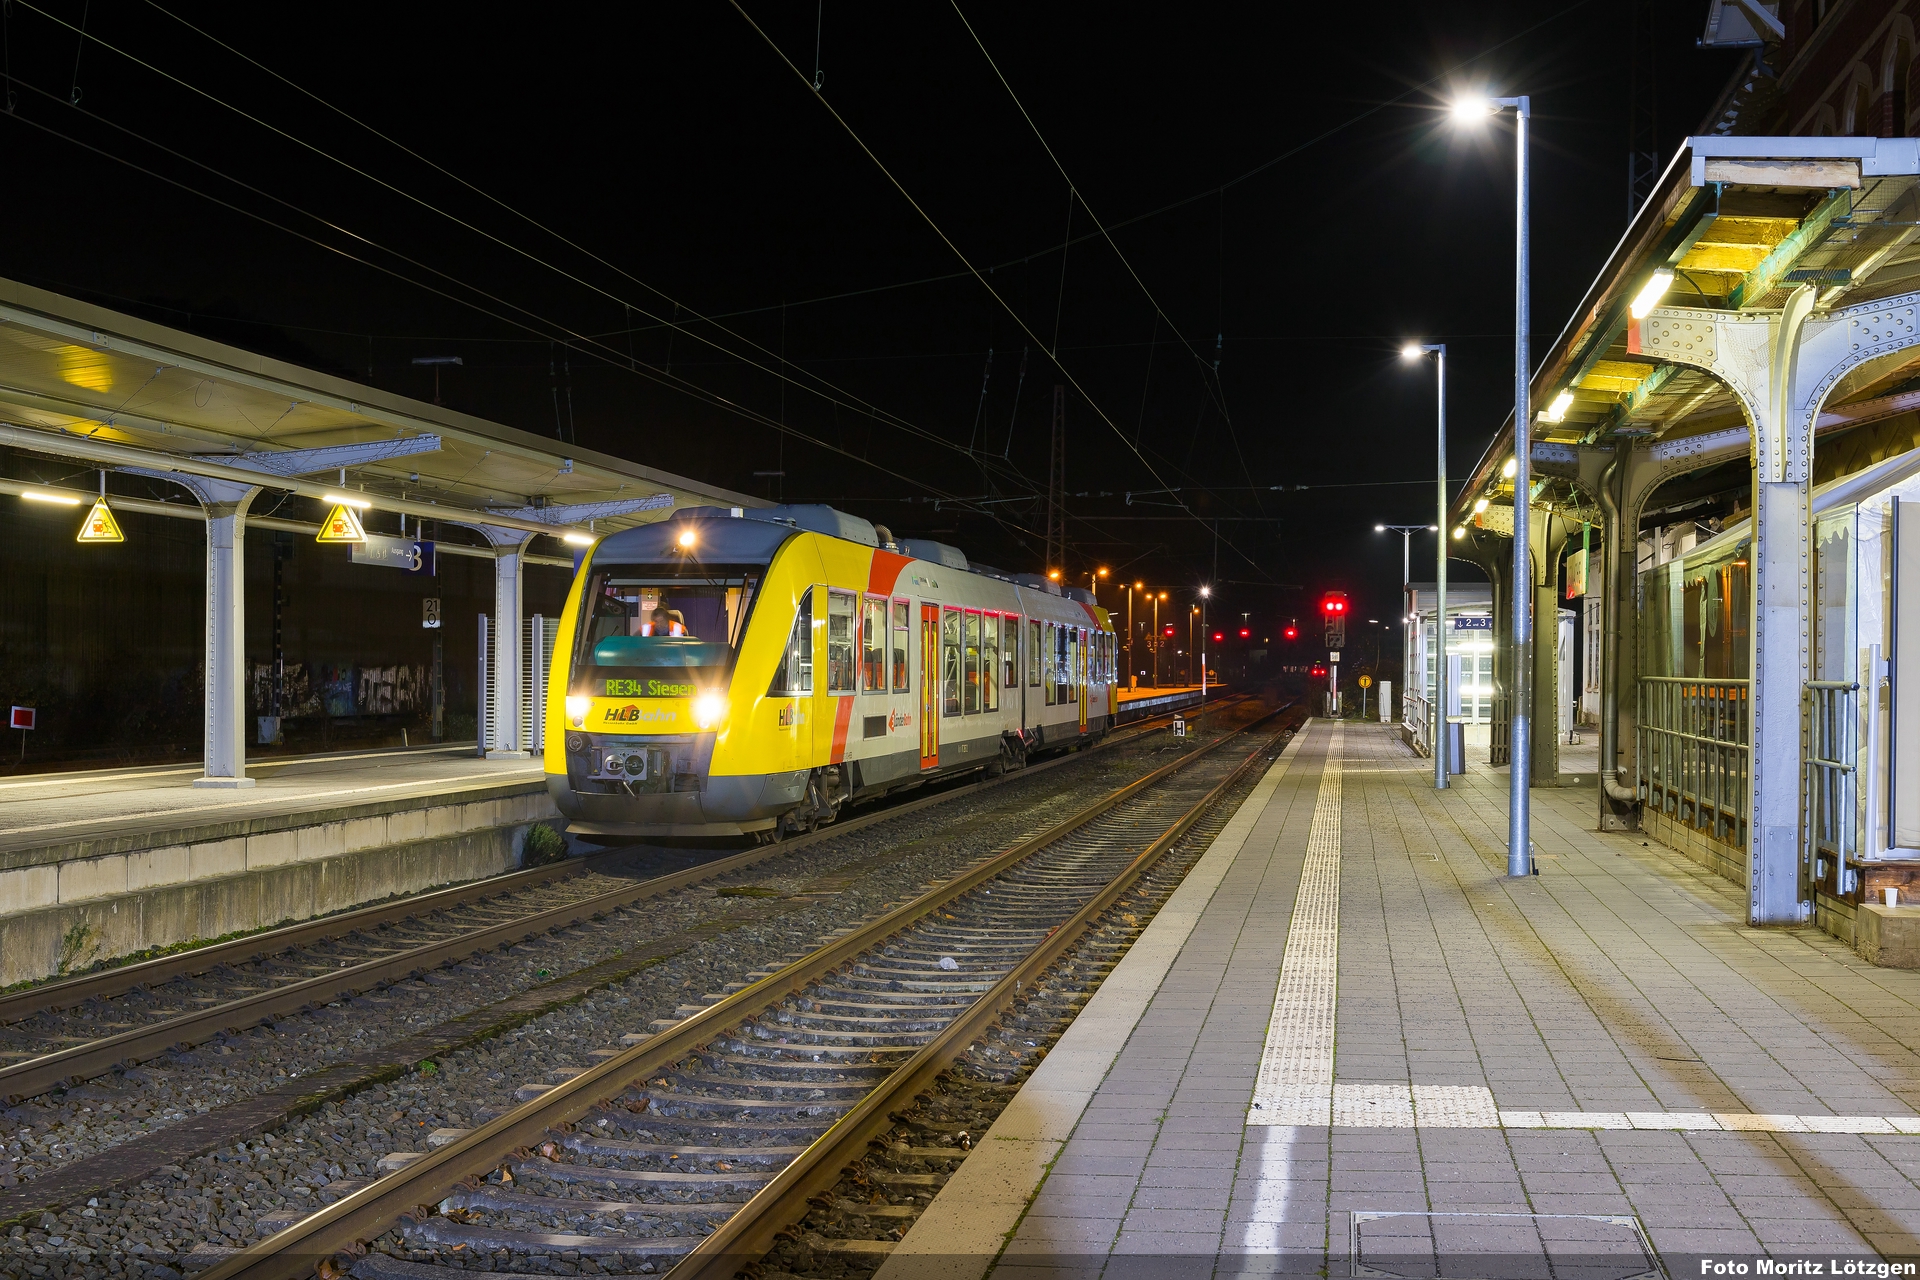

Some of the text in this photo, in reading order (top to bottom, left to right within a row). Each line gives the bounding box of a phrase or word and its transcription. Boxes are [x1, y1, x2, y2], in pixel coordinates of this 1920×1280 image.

[409, 545, 422, 571] 3
[426, 600, 437, 612] 21
[428, 613, 436, 625] 0
[1466, 619, 1472, 627] 2
[1480, 619, 1486, 627] 3
[606, 680, 697, 696] RE34 Siegen
[604, 708, 640, 722] HLB
[1174, 721, 1184, 736] H
